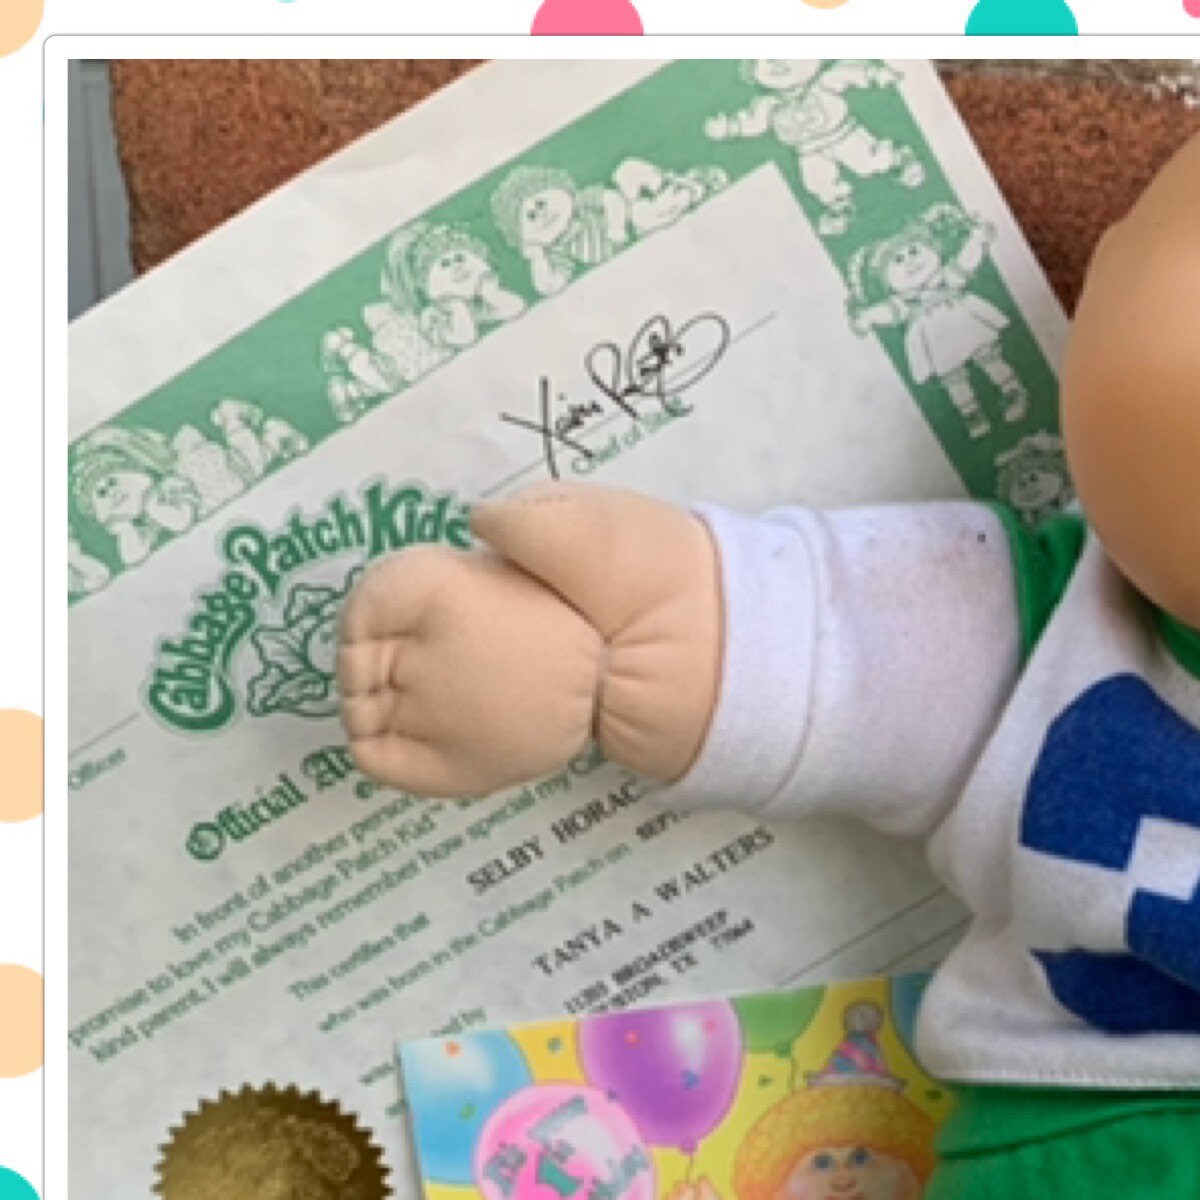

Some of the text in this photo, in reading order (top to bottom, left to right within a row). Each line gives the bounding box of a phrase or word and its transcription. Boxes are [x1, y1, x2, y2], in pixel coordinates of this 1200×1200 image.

[149, 571, 260, 731] Cabbage
[223, 498, 366, 597] Patch
[186, 772, 310, 861] Official
[195, 891, 250, 930] front
[248, 873, 271, 900] of
[272, 831, 349, 885] another
[466, 777, 642, 897] SELBY HORAC
[67, 988, 148, 1047] promise
[147, 972, 174, 995] to
[166, 948, 216, 982] love
[214, 928, 252, 954] my
[246, 873, 341, 933] Cabbage
[335, 837, 398, 880] Patch
[88, 1023, 139, 1063] kind
[216, 955, 252, 986] will
[251, 922, 318, 966] always
[316, 858, 422, 929] remember
[418, 834, 464, 867] how
[466, 785, 536, 839] special
[287, 911, 431, 1001] This certifies that
[385, 959, 434, 991] born
[430, 950, 453, 967] in
[448, 932, 480, 956] the
[477, 886, 556, 938] Cabbage
[552, 857, 605, 893] Patch
[531, 824, 776, 978] TANYA A WALTERS
